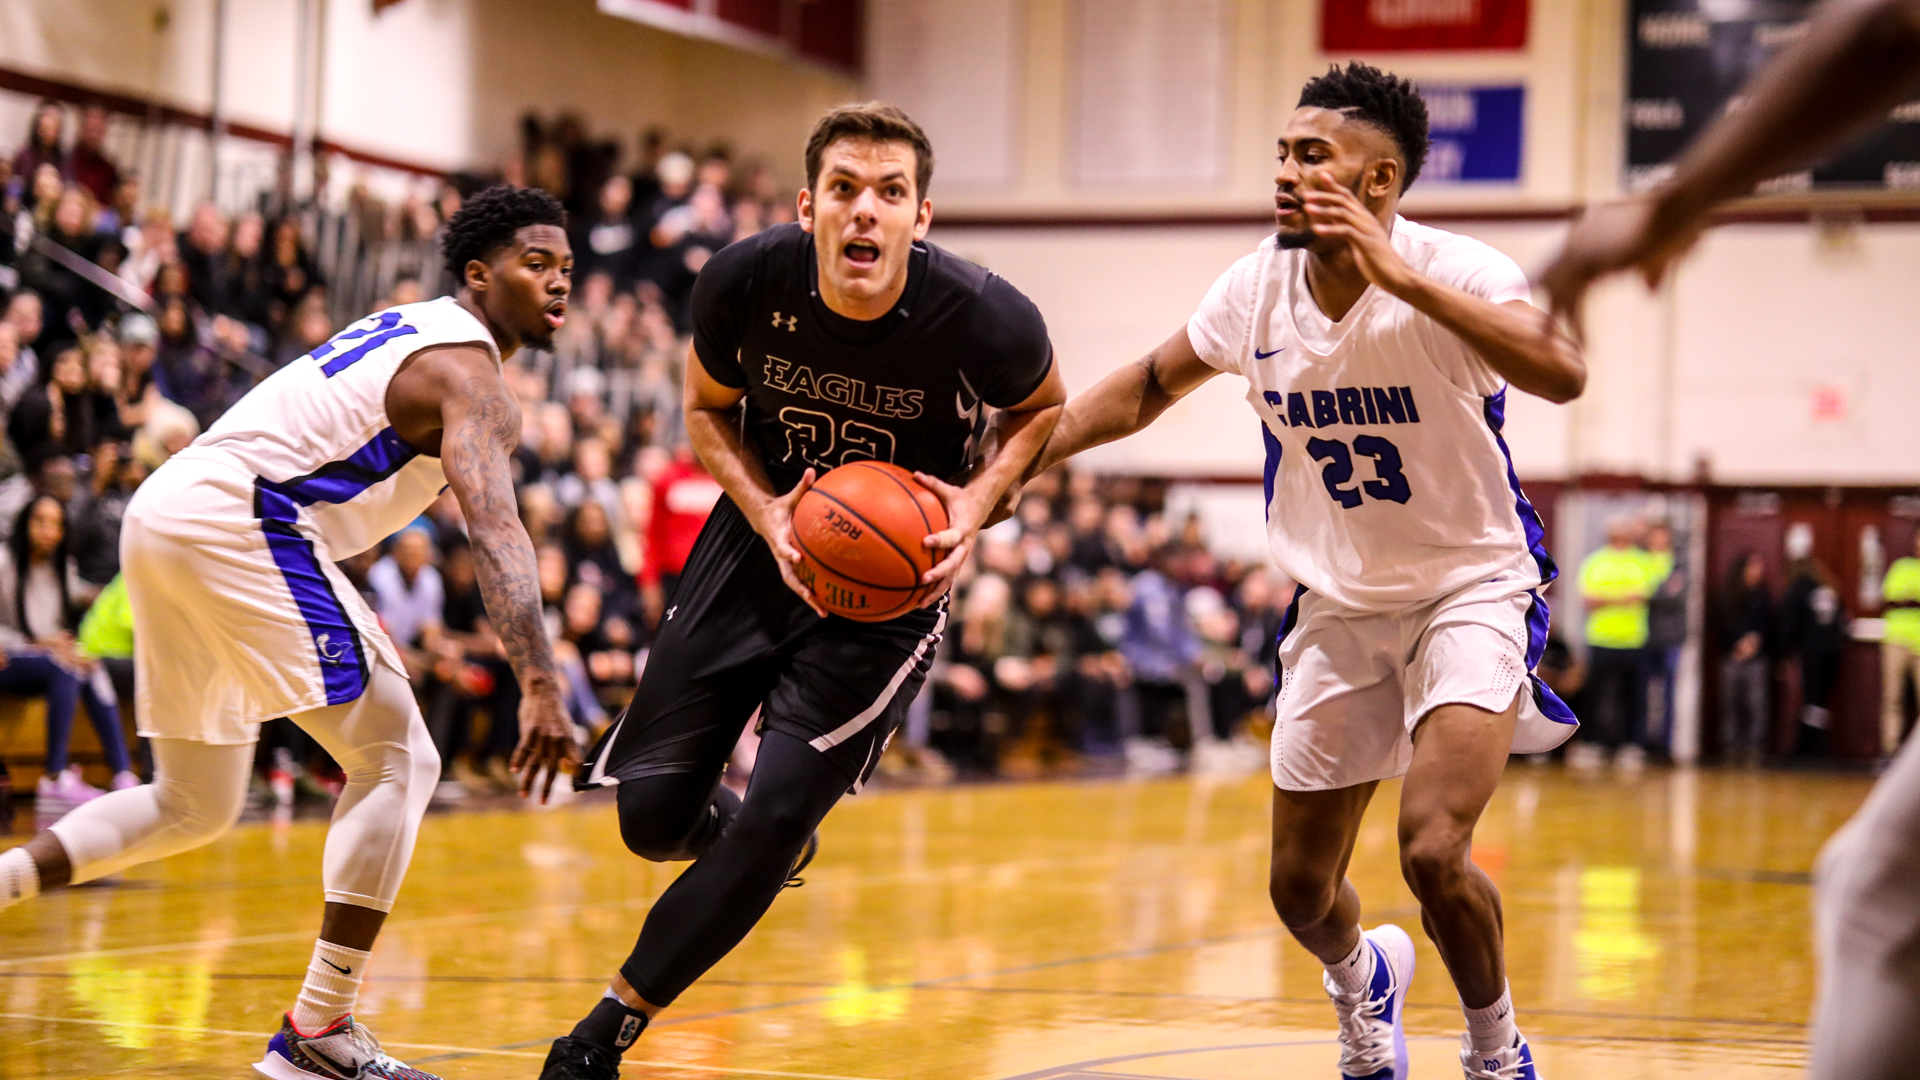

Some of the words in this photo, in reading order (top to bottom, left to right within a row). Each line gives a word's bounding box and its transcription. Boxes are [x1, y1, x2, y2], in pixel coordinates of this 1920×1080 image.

[308, 312, 419, 379] 21
[763, 354, 925, 420] EAGLES
[1305, 434, 1413, 510] 23
[824, 581, 871, 610] THE
